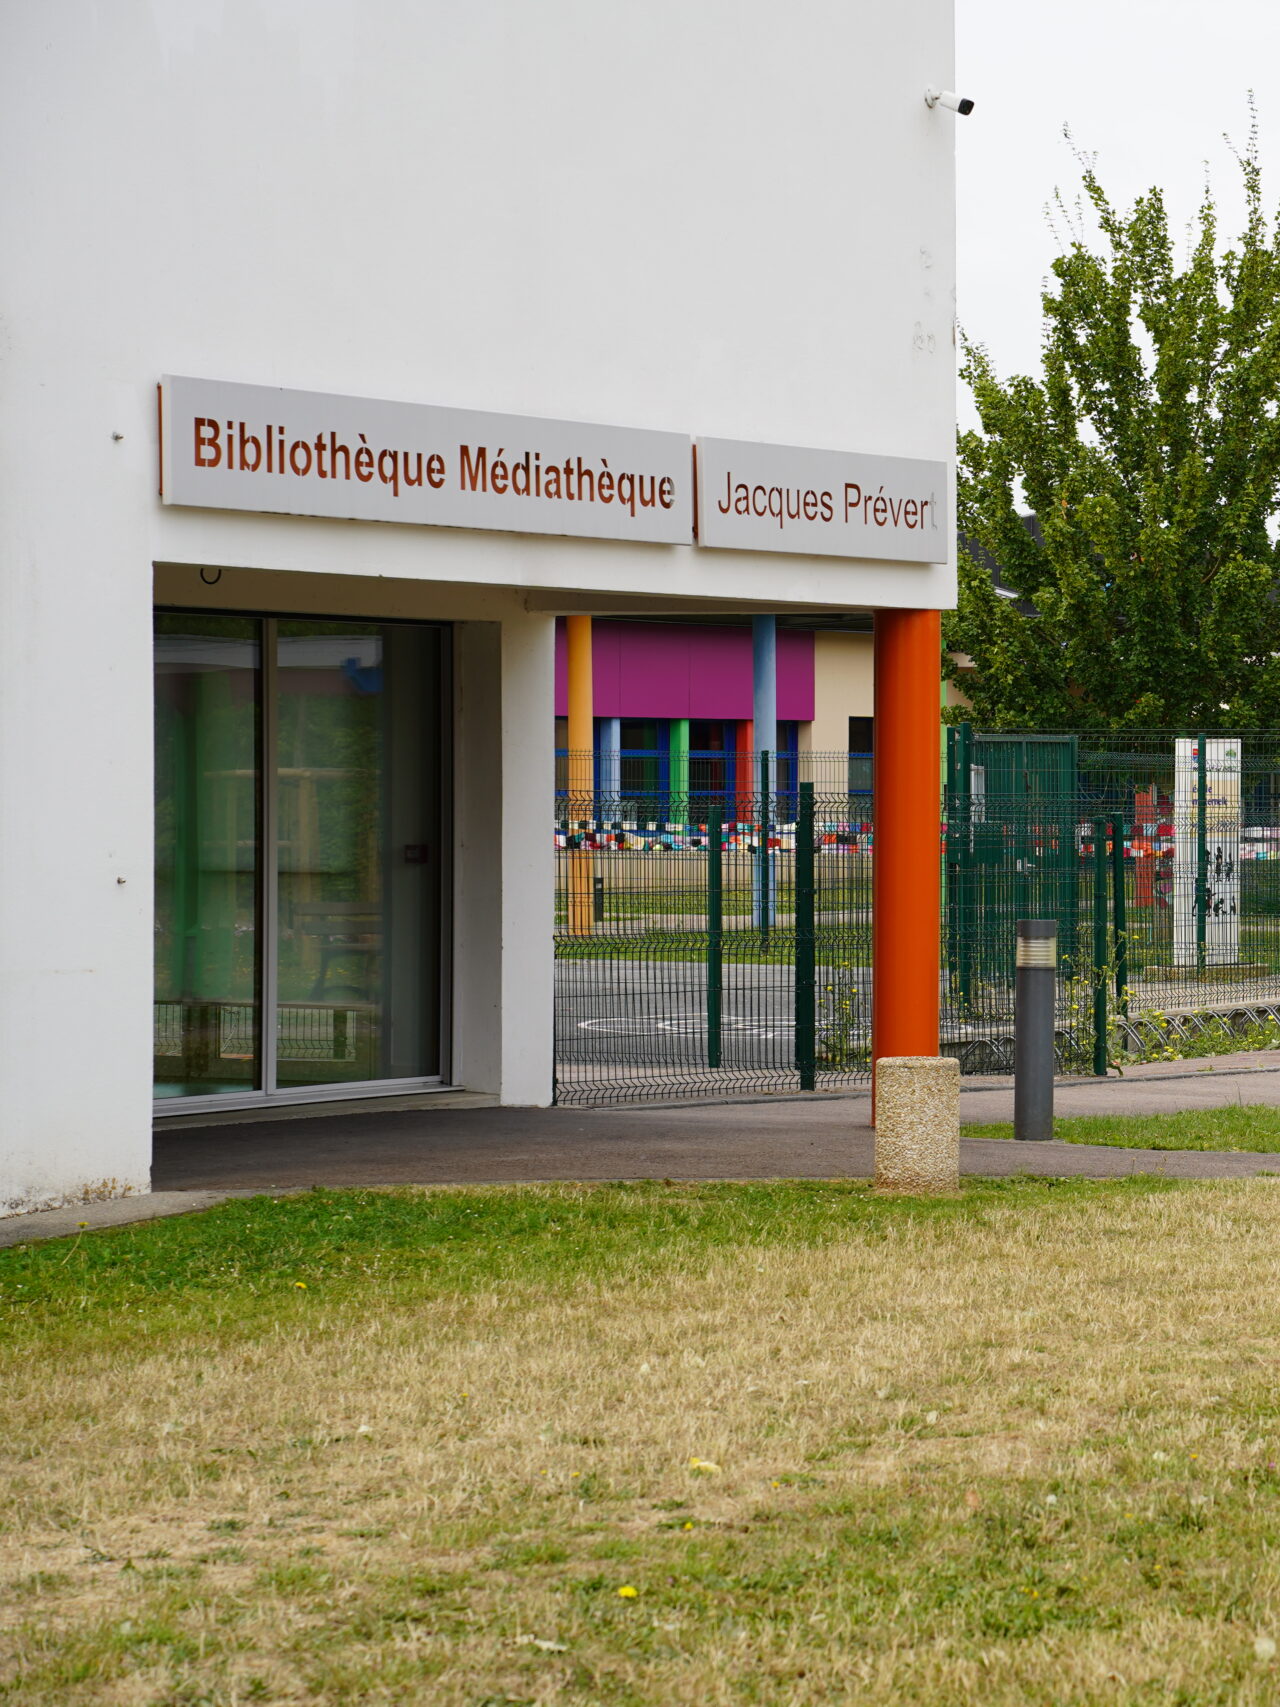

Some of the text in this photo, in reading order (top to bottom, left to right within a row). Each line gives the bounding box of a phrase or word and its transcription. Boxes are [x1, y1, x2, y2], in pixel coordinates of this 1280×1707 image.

[194, 417, 675, 517] Bibliothèque Médiathèque
[718, 471, 938, 529] Jacques Prévert
